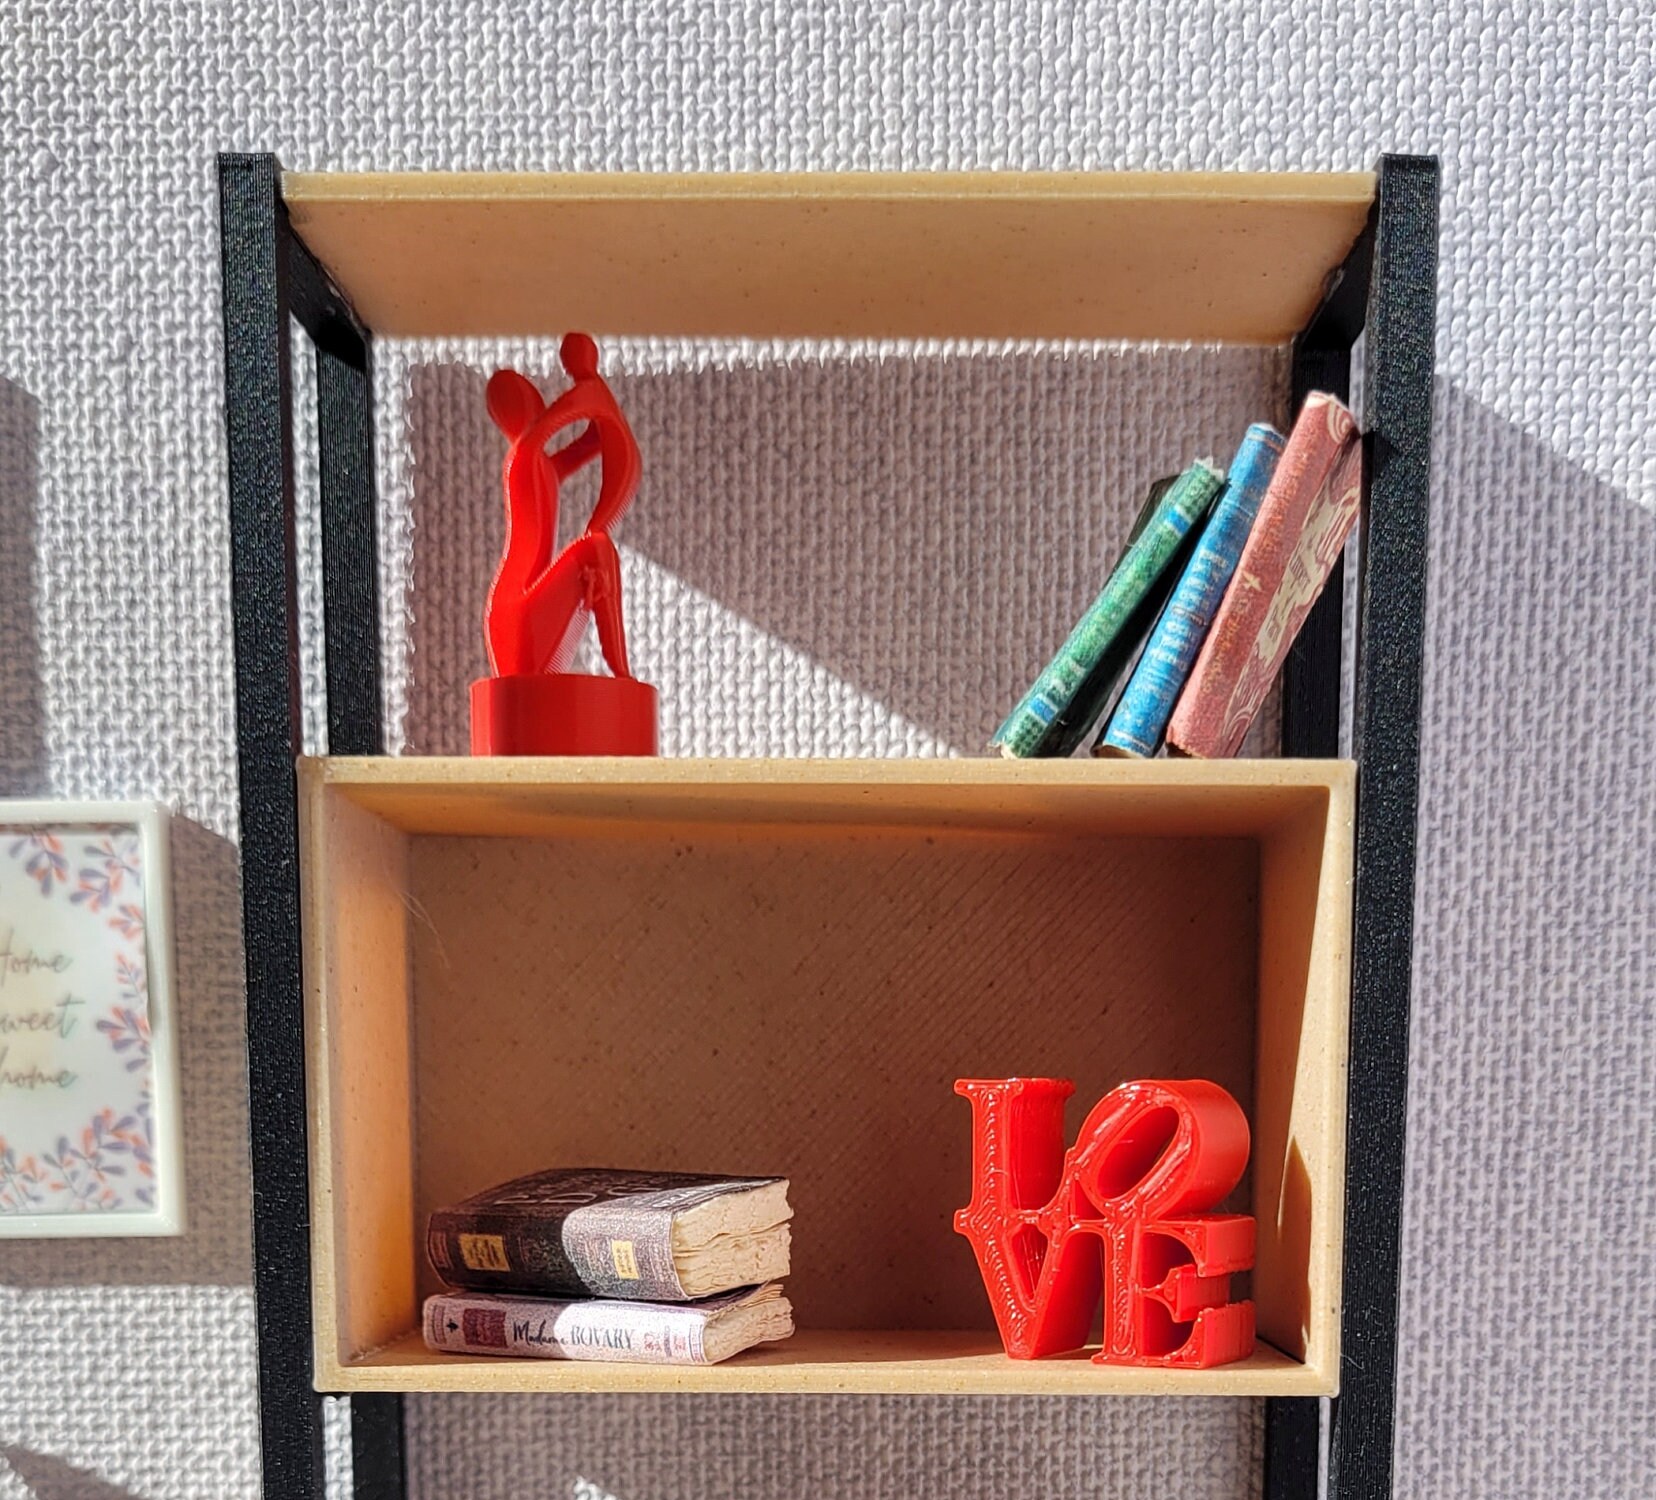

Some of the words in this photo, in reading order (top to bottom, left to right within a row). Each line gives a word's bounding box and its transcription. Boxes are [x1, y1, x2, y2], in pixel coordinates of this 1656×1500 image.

[0, 993, 86, 1039] weet
[513, 1319, 569, 1346] Madame
[571, 1325, 635, 1349] BOVARY
